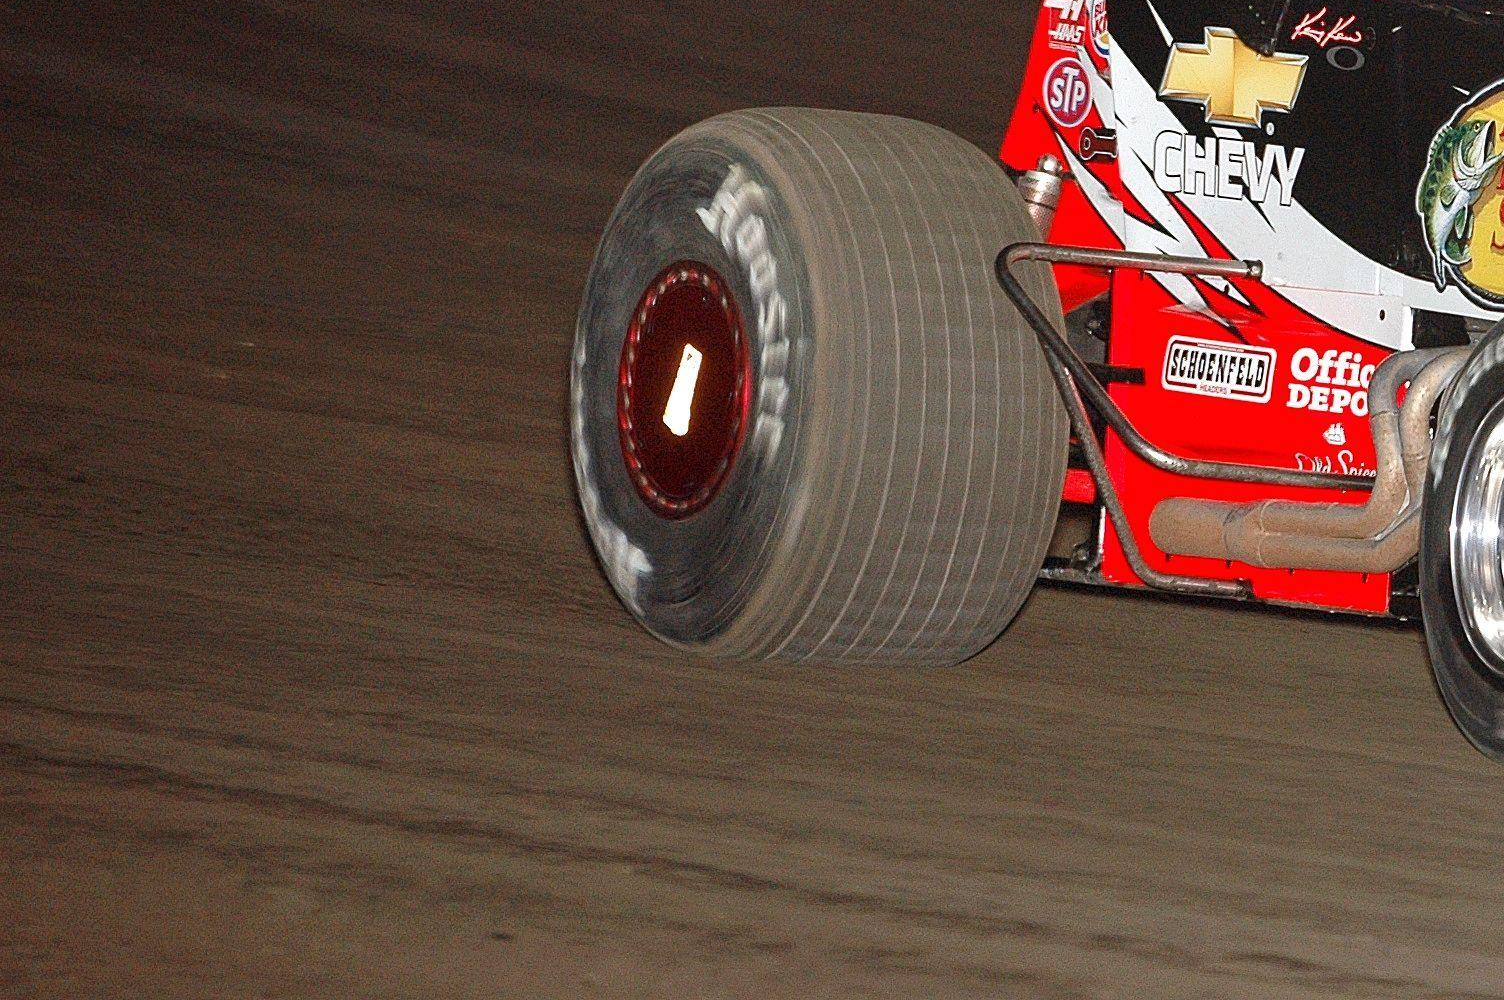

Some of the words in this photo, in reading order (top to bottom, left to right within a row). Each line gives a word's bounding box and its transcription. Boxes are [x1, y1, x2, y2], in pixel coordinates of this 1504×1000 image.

[1050, 66, 1087, 113] STP
[1153, 130, 1306, 206] CHEVY
[1170, 347, 1266, 388] SCHOENFELD
[1290, 347, 1376, 389] Offic
[1286, 382, 1369, 417] DEPO
